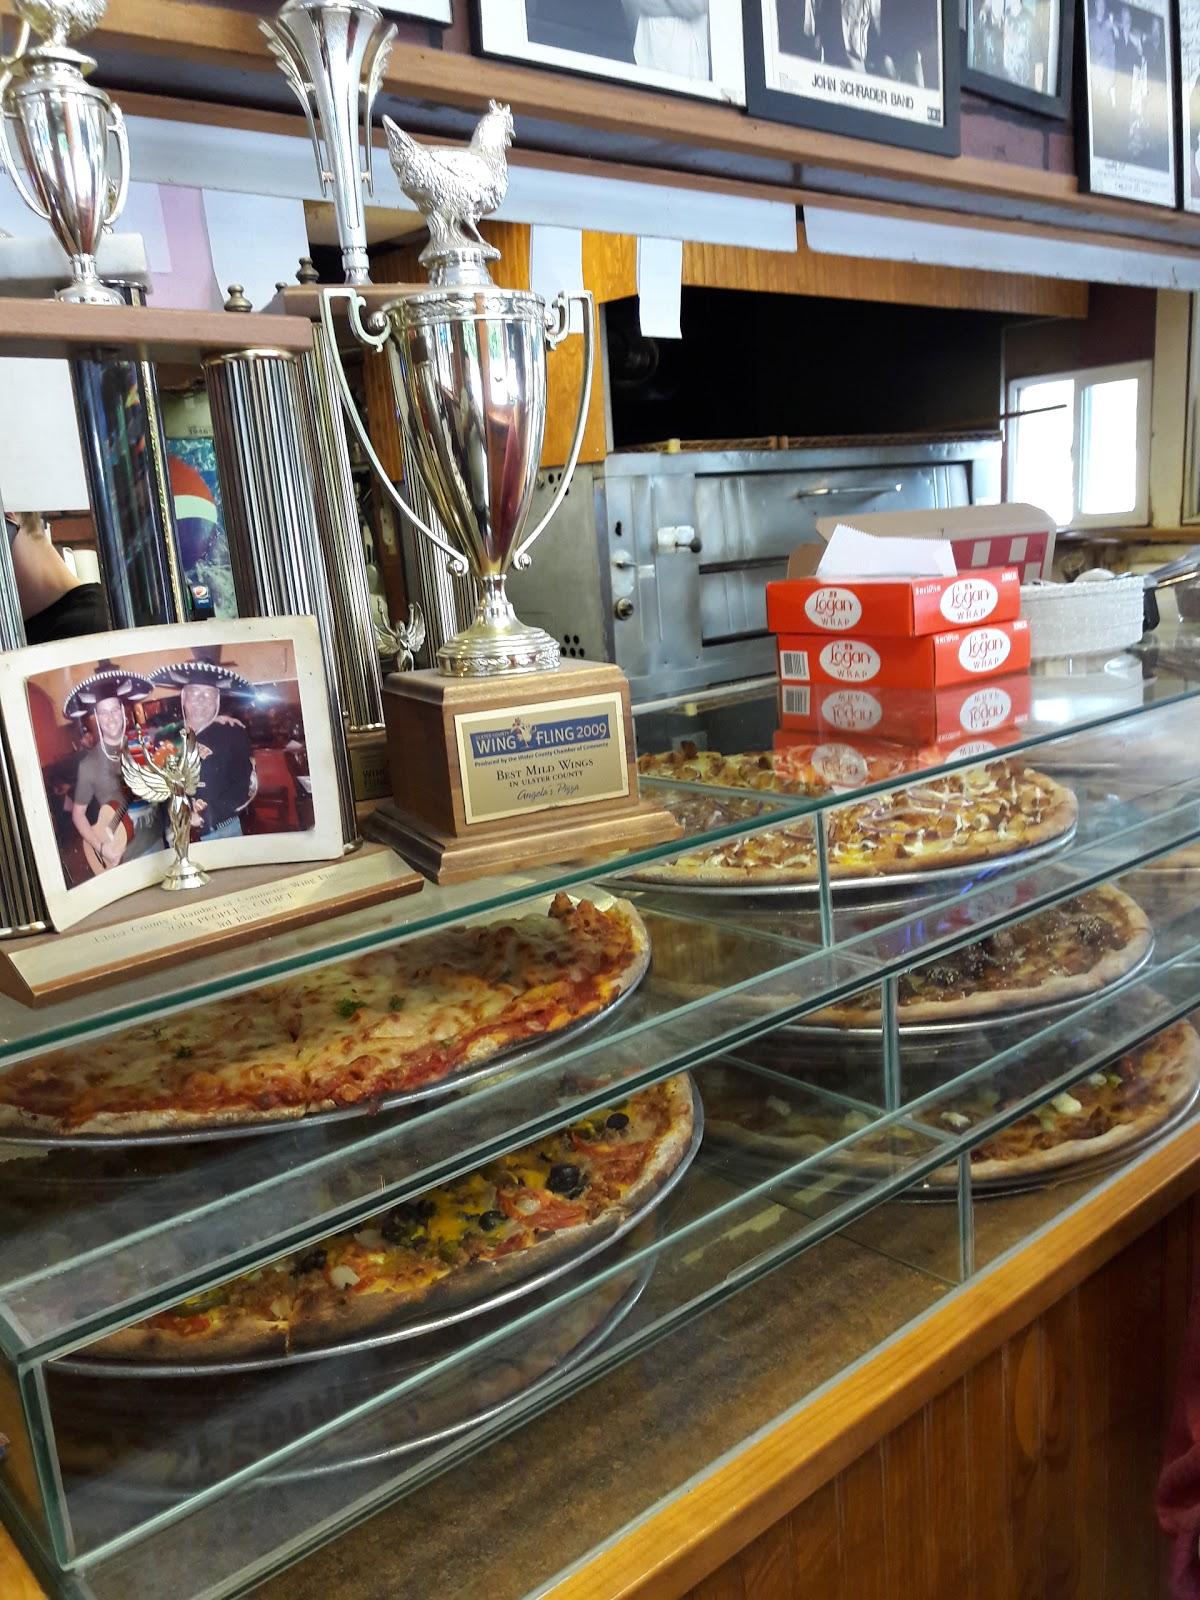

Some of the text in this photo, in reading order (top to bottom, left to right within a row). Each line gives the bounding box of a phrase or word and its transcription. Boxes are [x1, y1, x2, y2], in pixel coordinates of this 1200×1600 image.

[812, 73, 914, 110] JOHN SCHRADER BAND
[815, 591, 853, 617] Logan
[951, 584, 990, 609] Logan
[822, 618, 850, 626] WRAP
[957, 608, 985, 620] WRAP
[831, 643, 871, 669] Logan
[969, 635, 1003, 659] Logan
[838, 670, 867, 678] WRAP
[973, 658, 999, 669] WRAP
[476, 722, 607, 754] WING FLING 2009
[496, 759, 594, 781] BEST MILD WINGS
[509, 770, 583, 788] IN ULSTER COUNTY
